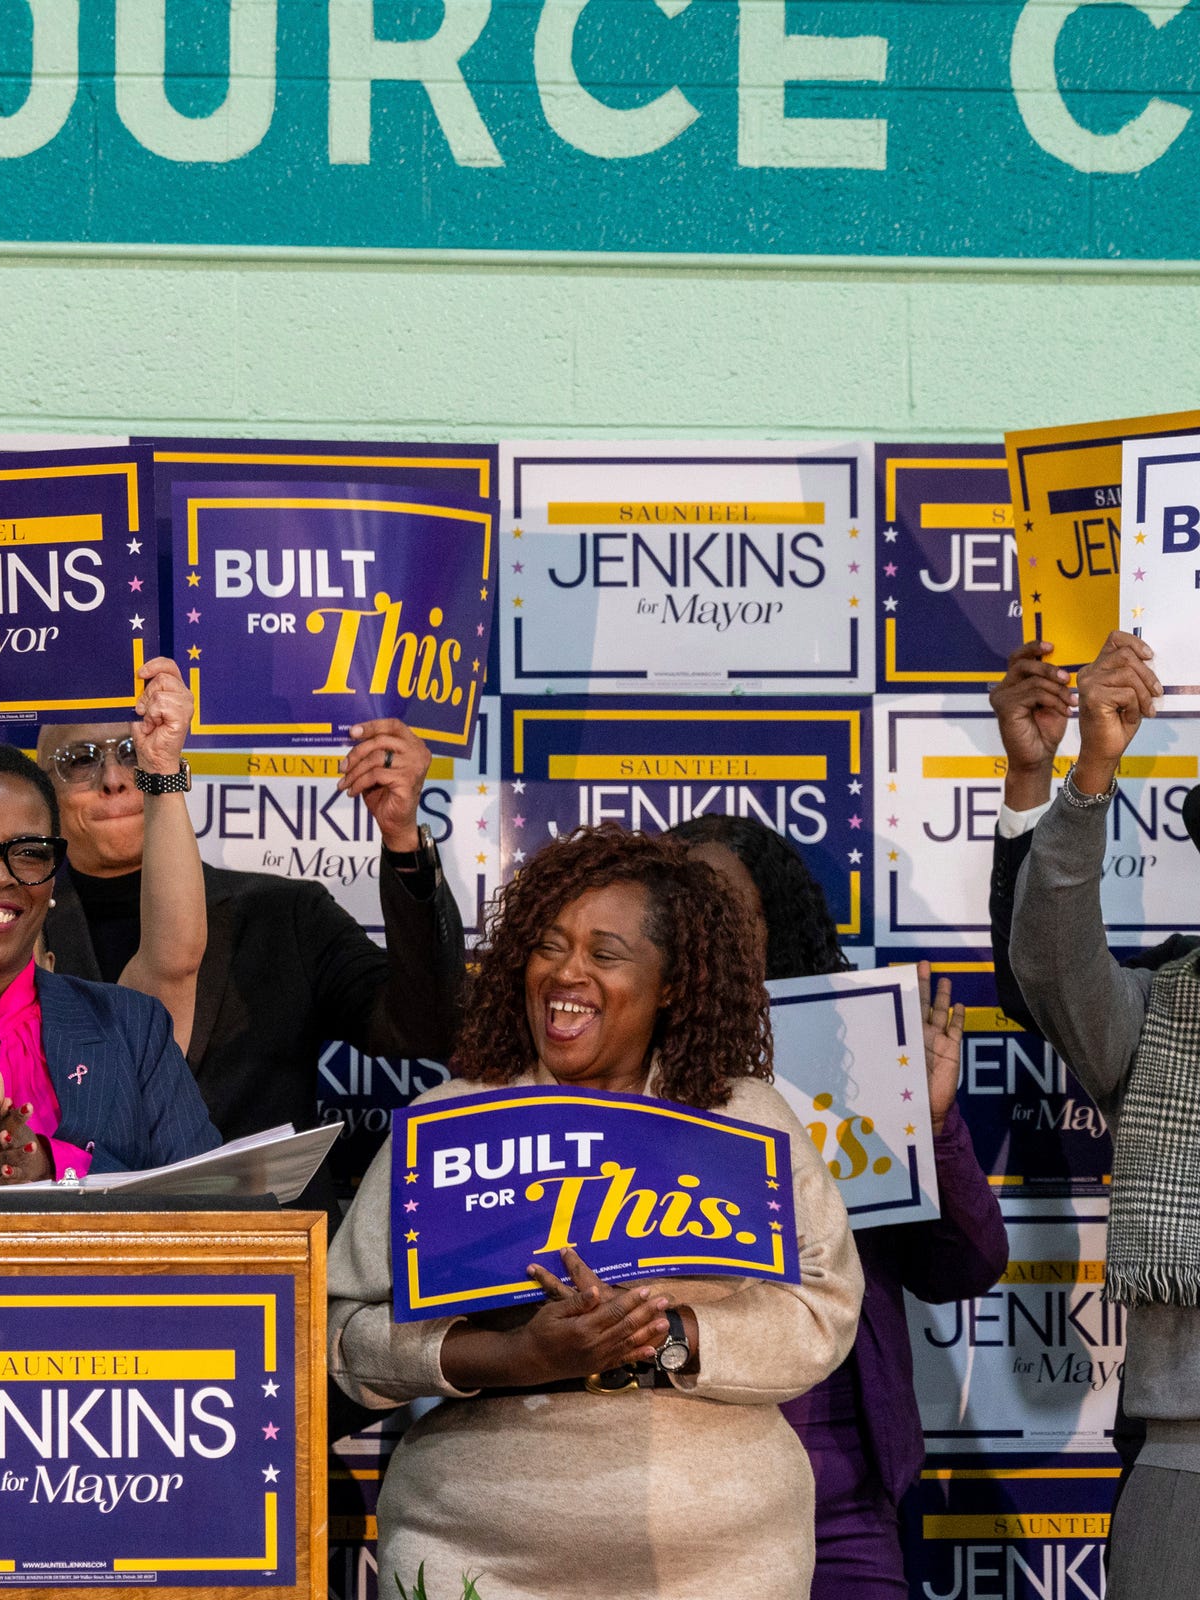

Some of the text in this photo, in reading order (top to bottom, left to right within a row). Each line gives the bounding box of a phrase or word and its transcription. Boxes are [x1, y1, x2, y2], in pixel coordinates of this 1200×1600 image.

[620, 505, 756, 521] SAUNTEEL
[214, 549, 376, 599] BUILT
[548, 532, 826, 589] JENKINS
[636, 594, 783, 632] for Mayor
[247, 591, 464, 707] FOR This.
[620, 759, 757, 776] SAUNTEEL
[262, 850, 284, 867] for
[1011, 1103, 1035, 1121] for
[433, 1131, 604, 1189] BUILT
[465, 1160, 757, 1255] FOR This.
[1012, 1356, 1035, 1374] for
[0, 1465, 183, 1514] for Mayor
